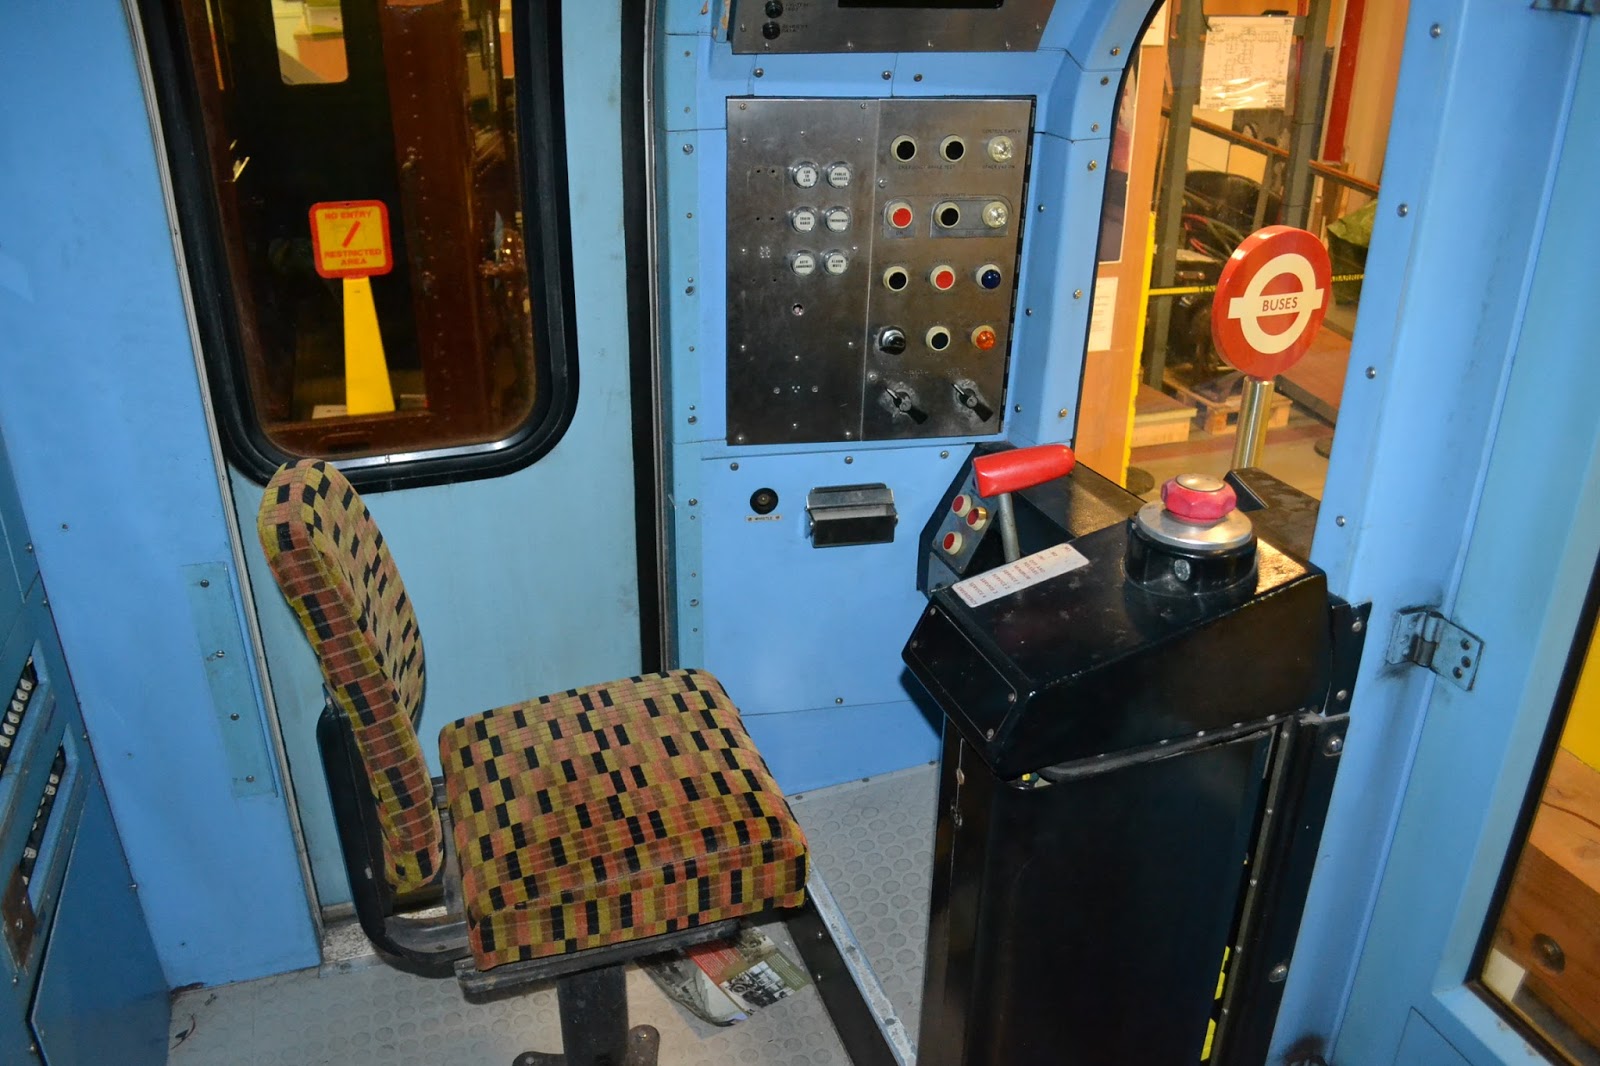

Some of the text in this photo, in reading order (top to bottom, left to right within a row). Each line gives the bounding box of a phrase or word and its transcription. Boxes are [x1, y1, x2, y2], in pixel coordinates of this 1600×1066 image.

[341, 210, 371, 219] ENTRY
[324, 248, 382, 258] RESTRICTED
[341, 258, 368, 266] AREA
[1262, 296, 1298, 312] BUSES
